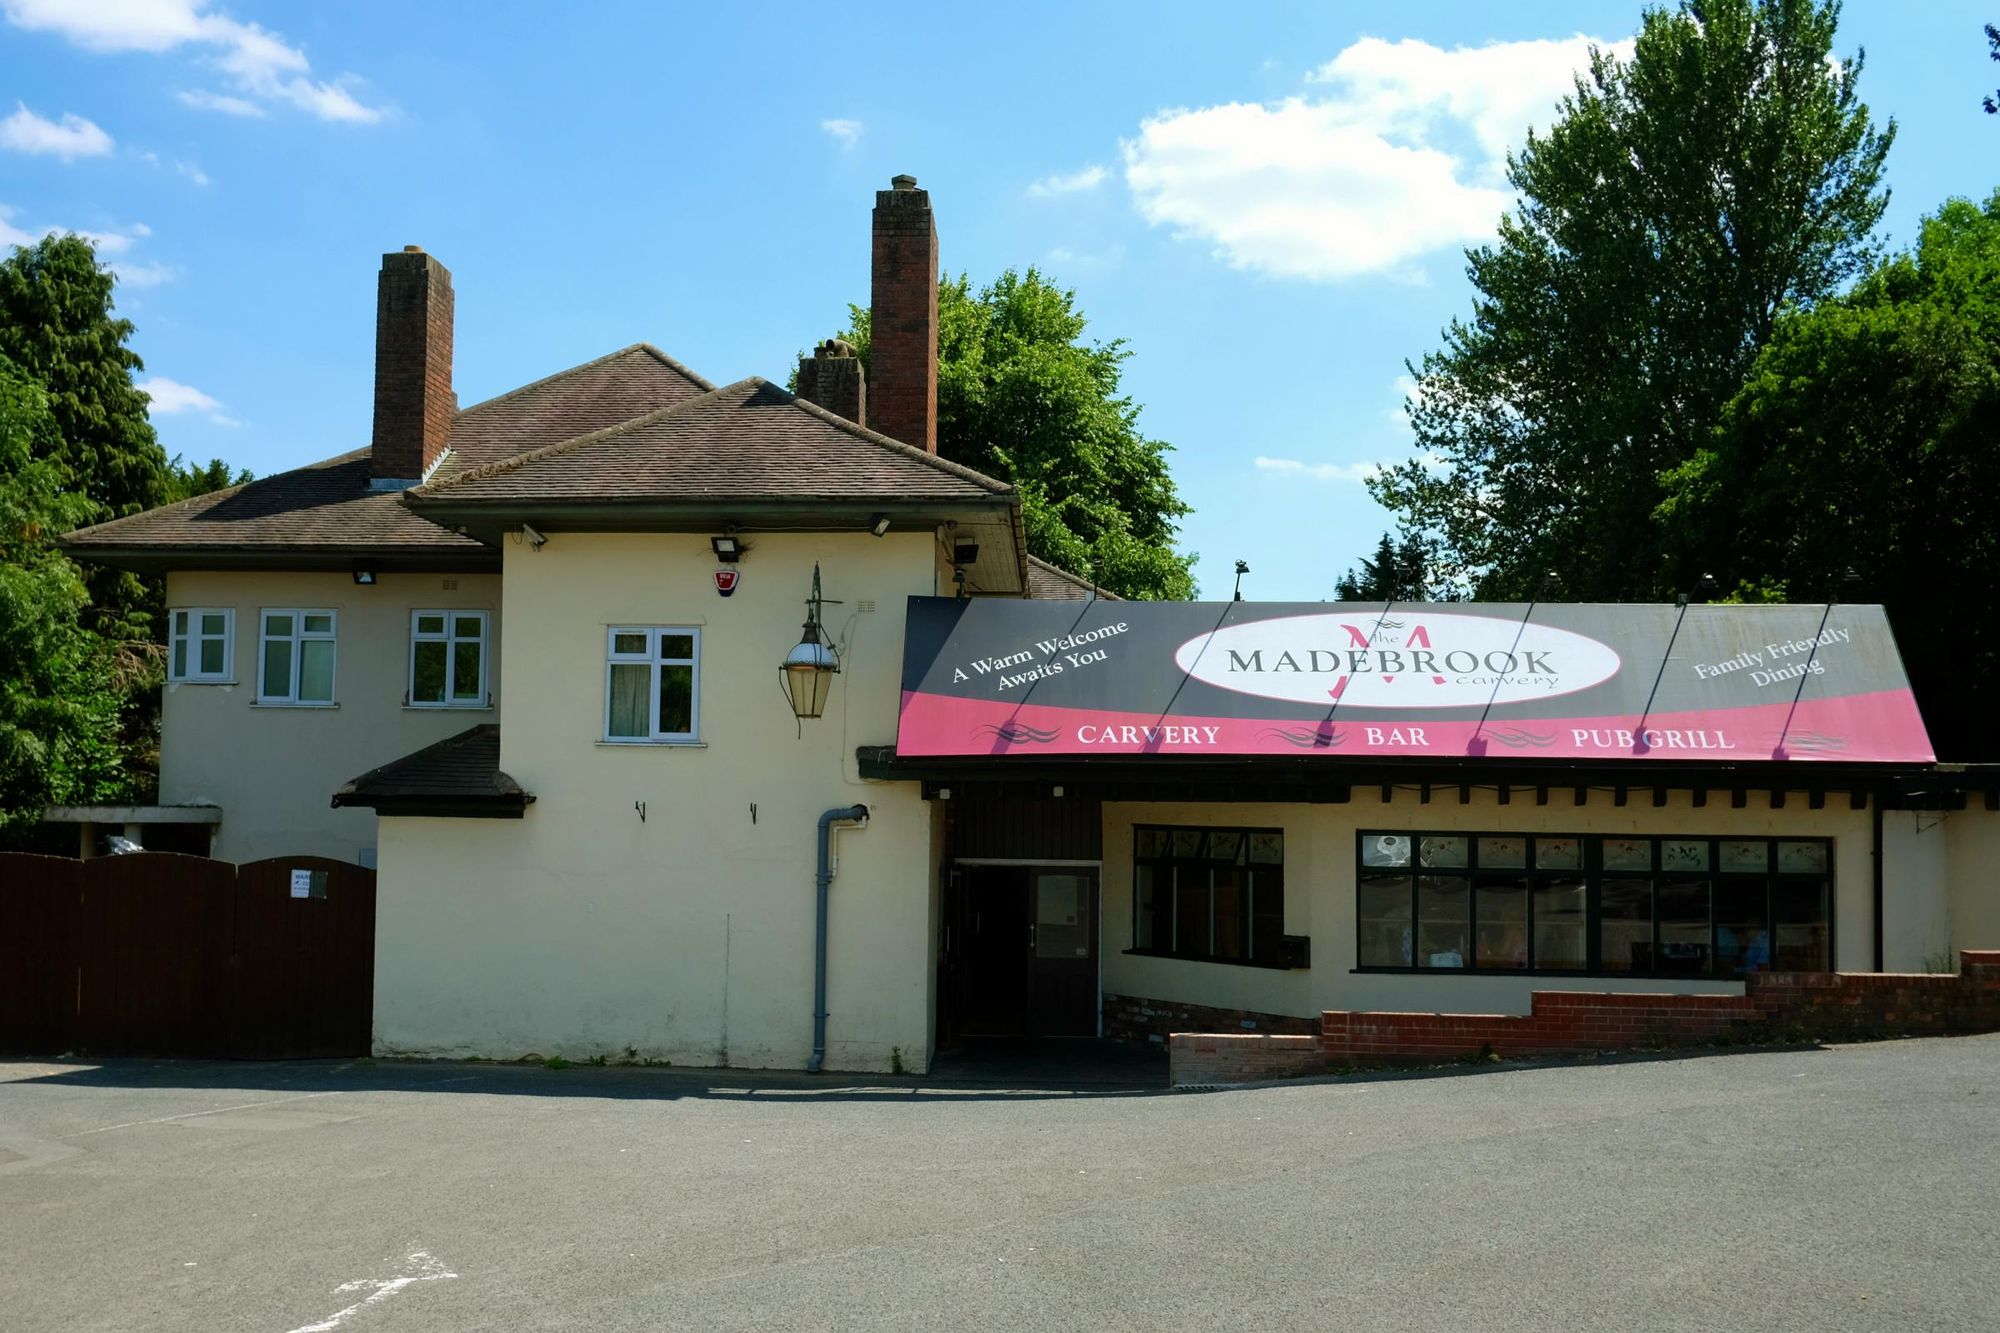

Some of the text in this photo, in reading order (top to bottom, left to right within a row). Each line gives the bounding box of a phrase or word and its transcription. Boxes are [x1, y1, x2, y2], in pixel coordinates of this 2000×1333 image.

[953, 621, 1129, 684] A Warm Welcome
[1227, 650, 1558, 674] MADEBROOK
[1693, 628, 1850, 680] Family Friendly
[998, 649, 1109, 691] Awaits You
[1749, 658, 1825, 687] Dining
[1456, 676, 1559, 689] carvery
[1077, 725, 1220, 744] CARVERY
[1365, 727, 1430, 746] BAR
[1571, 729, 1735, 749] PUB GRILL
